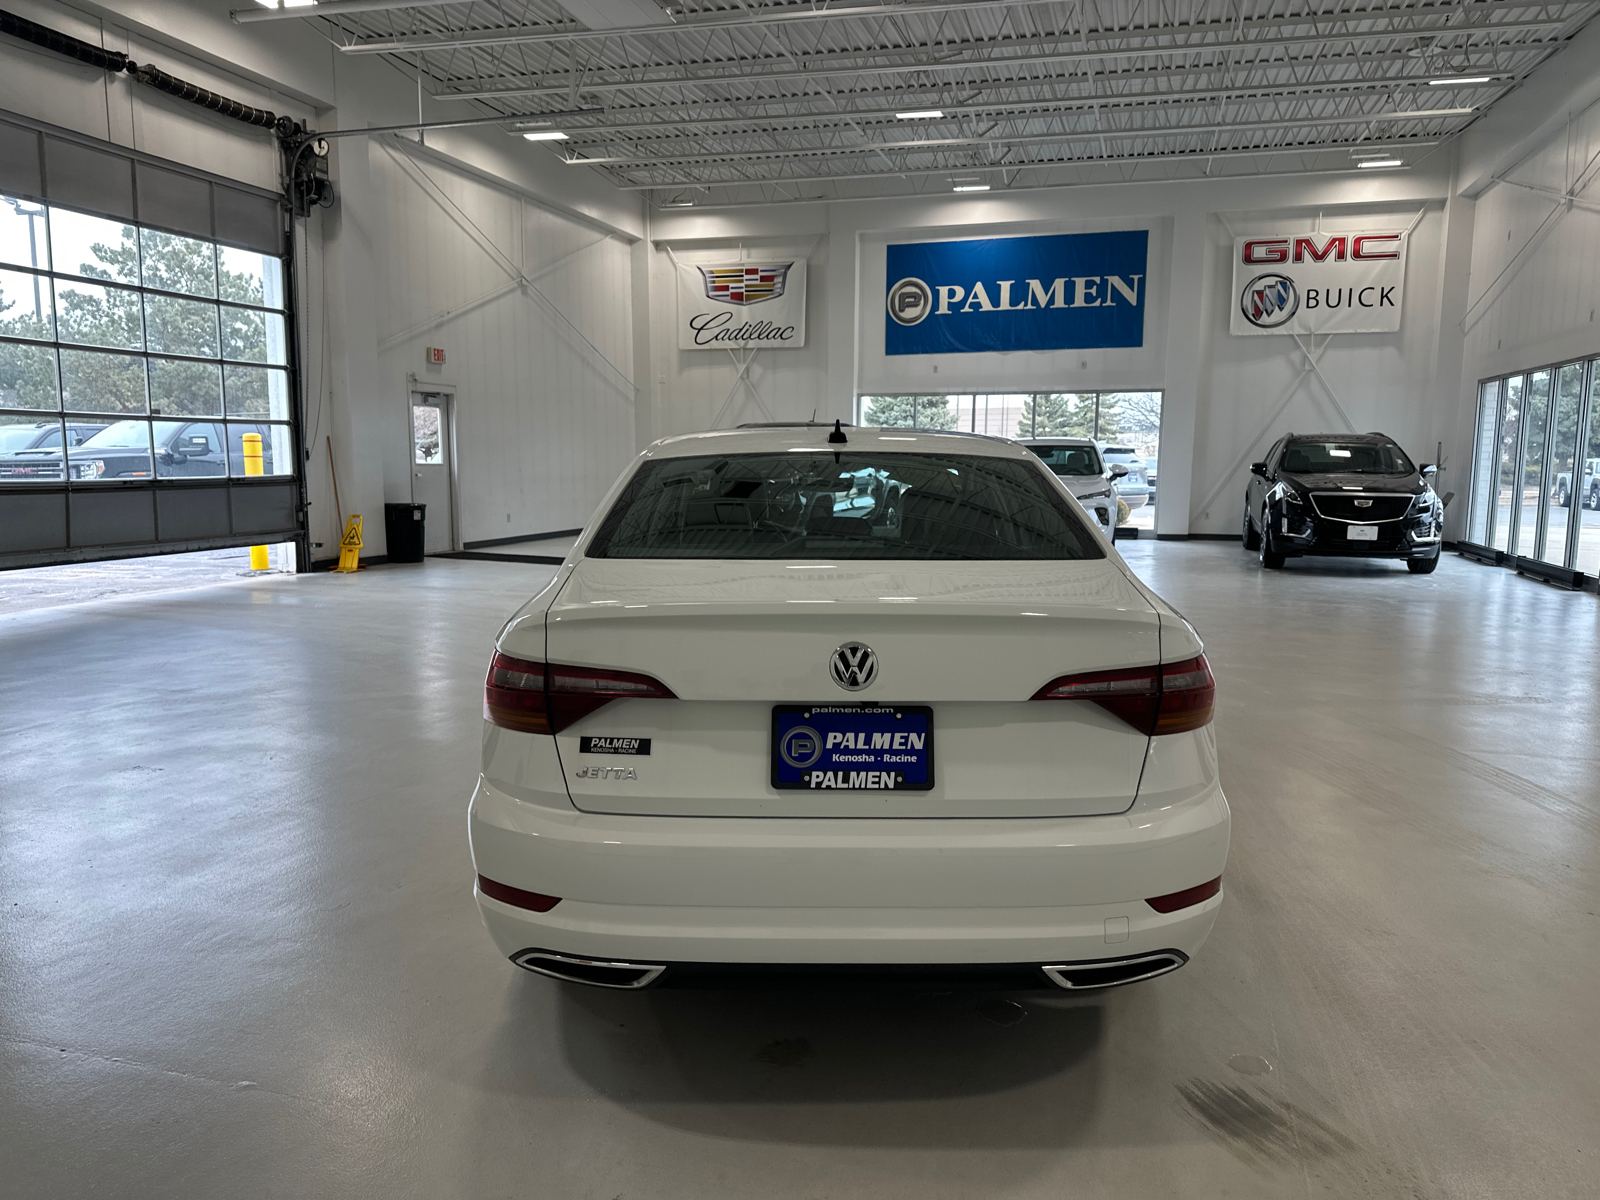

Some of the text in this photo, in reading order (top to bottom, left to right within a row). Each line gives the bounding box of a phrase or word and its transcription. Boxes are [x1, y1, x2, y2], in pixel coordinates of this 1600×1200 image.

[1242, 233, 1401, 266] GMC
[934, 274, 1143, 315] PALMEN
[1306, 286, 1396, 309] BUICK
[689, 311, 795, 346] Cadillac
[811, 706, 894, 714] palmen.com
[590, 738, 640, 749] PALMEN
[825, 732, 926, 750] PALMEN
[832, 753, 875, 763] Kenosha
[883, 754, 918, 763] Racine
[575, 766, 638, 780] JETTA
[810, 771, 896, 789] PALMEN
